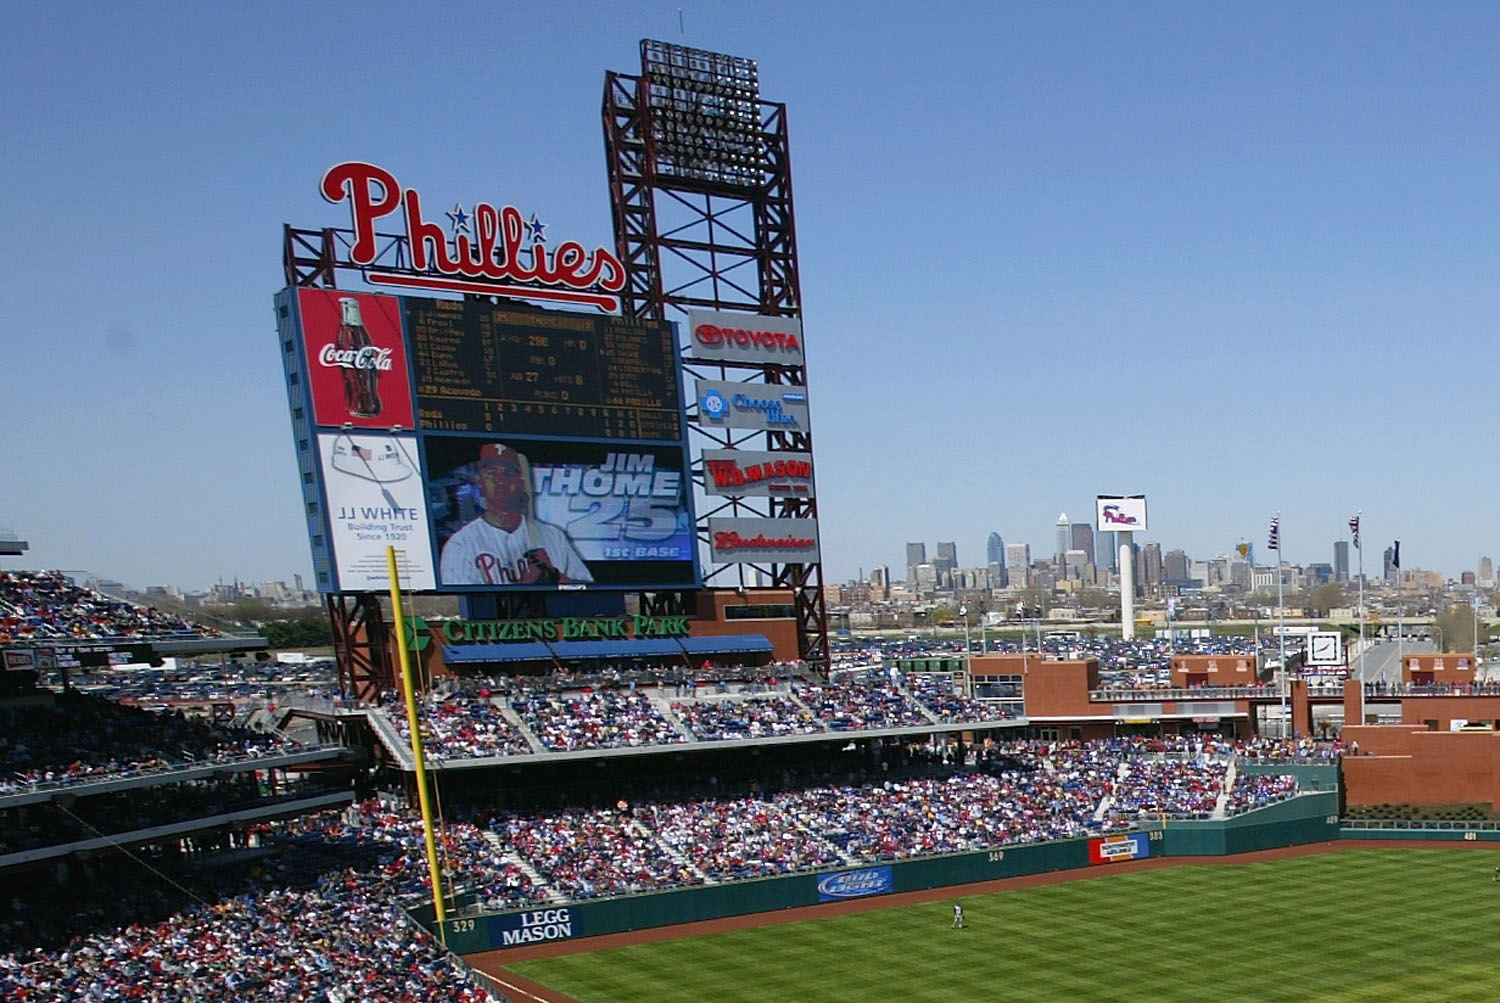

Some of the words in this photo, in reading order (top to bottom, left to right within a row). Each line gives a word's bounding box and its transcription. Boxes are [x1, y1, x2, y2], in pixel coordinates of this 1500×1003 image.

[320, 161, 626, 291] Phillies
[720, 327, 800, 349] TOYOTA
[318, 343, 393, 371] Coca-Cola
[600, 453, 655, 473] JIM
[532, 467, 682, 498] THOME
[337, 507, 356, 520] JJ
[361, 507, 418, 520] WHITE
[566, 496, 680, 542] 25
[348, 523, 388, 532] Building
[390, 523, 414, 532] Trust
[604, 546, 630, 558] 1st
[634, 546, 681, 558] BASE
[713, 532, 815, 551] Budweiser
[443, 619, 557, 642] CITIZENS
[562, 616, 627, 638] BANK
[633, 614, 690, 635] PARK
[452, 919, 475, 933] 329
[521, 908, 571, 928] LEGG
[501, 922, 572, 946] MASON
